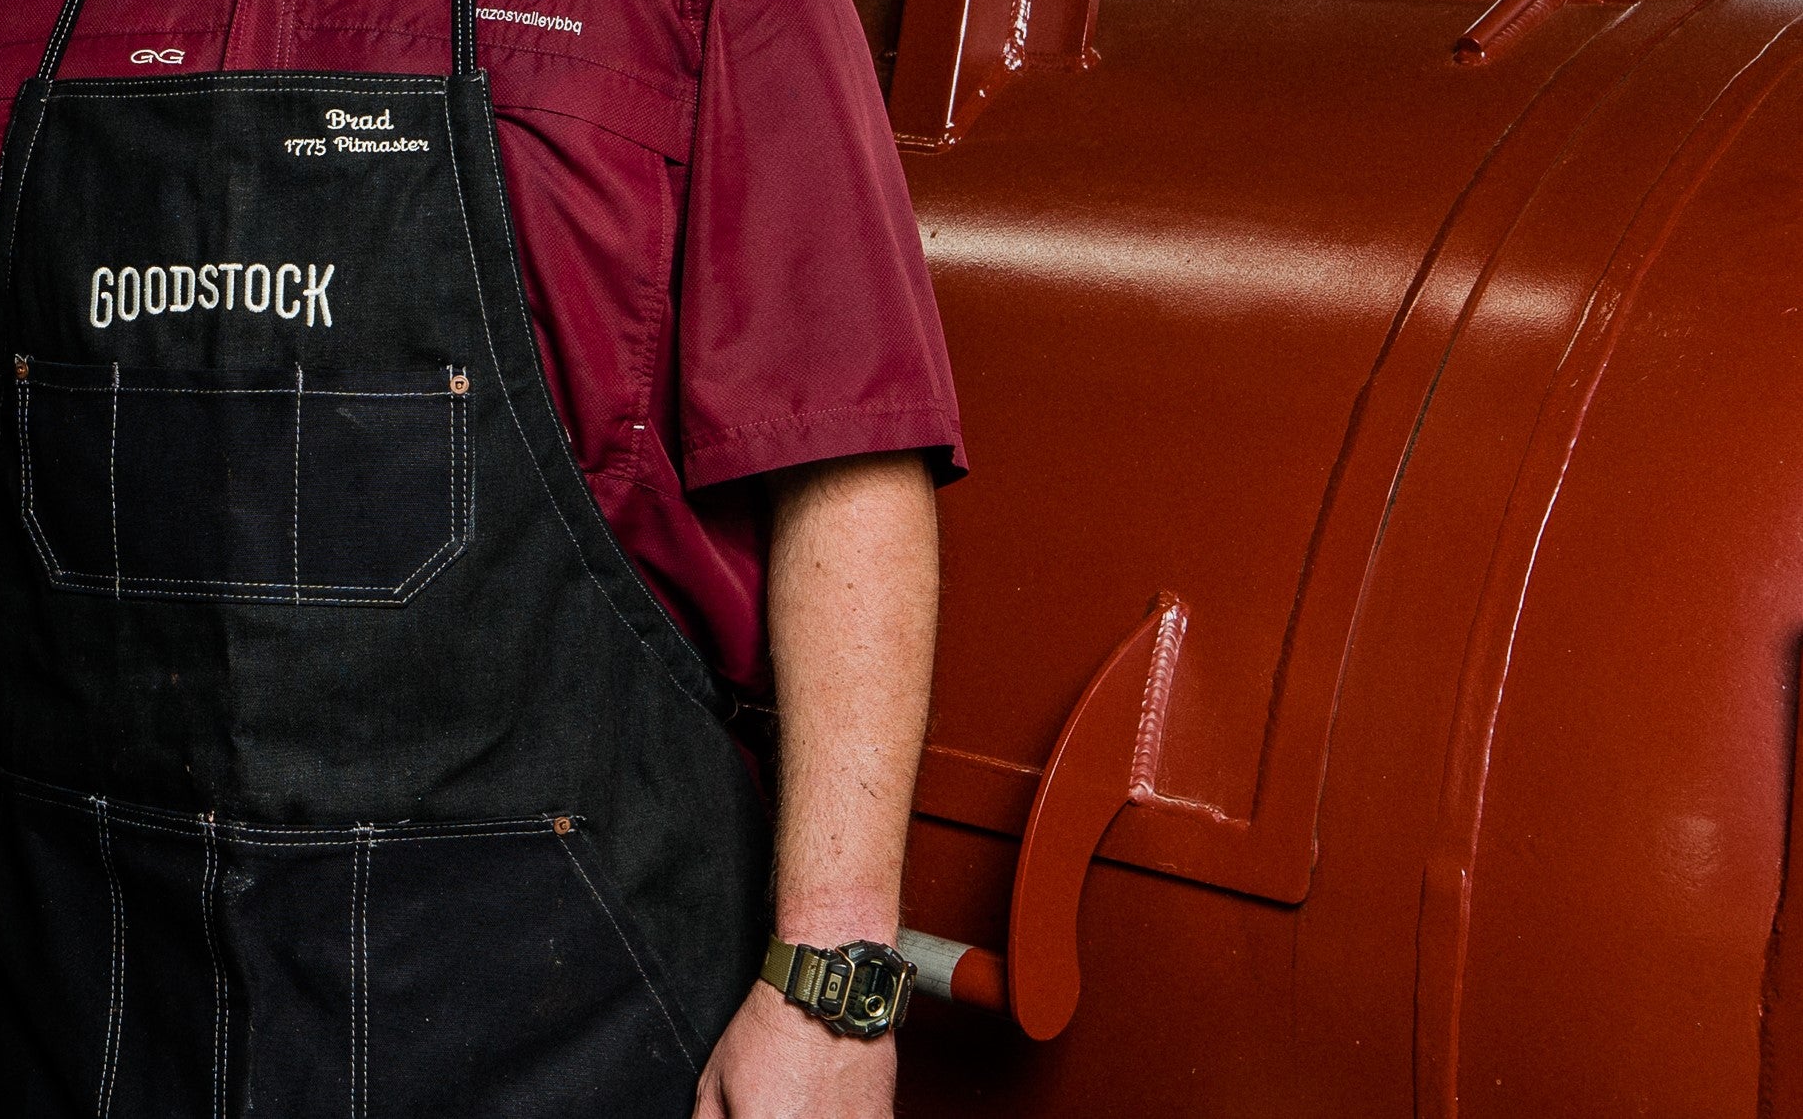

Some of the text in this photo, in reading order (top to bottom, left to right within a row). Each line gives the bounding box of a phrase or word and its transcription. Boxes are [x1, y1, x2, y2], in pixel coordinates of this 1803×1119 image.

[476, 7, 583, 36] razosvalleybbq
[325, 108, 395, 131] Brad
[284, 136, 430, 156] 1775 Pitmaster
[90, 263, 335, 329] GOODSTOCK
